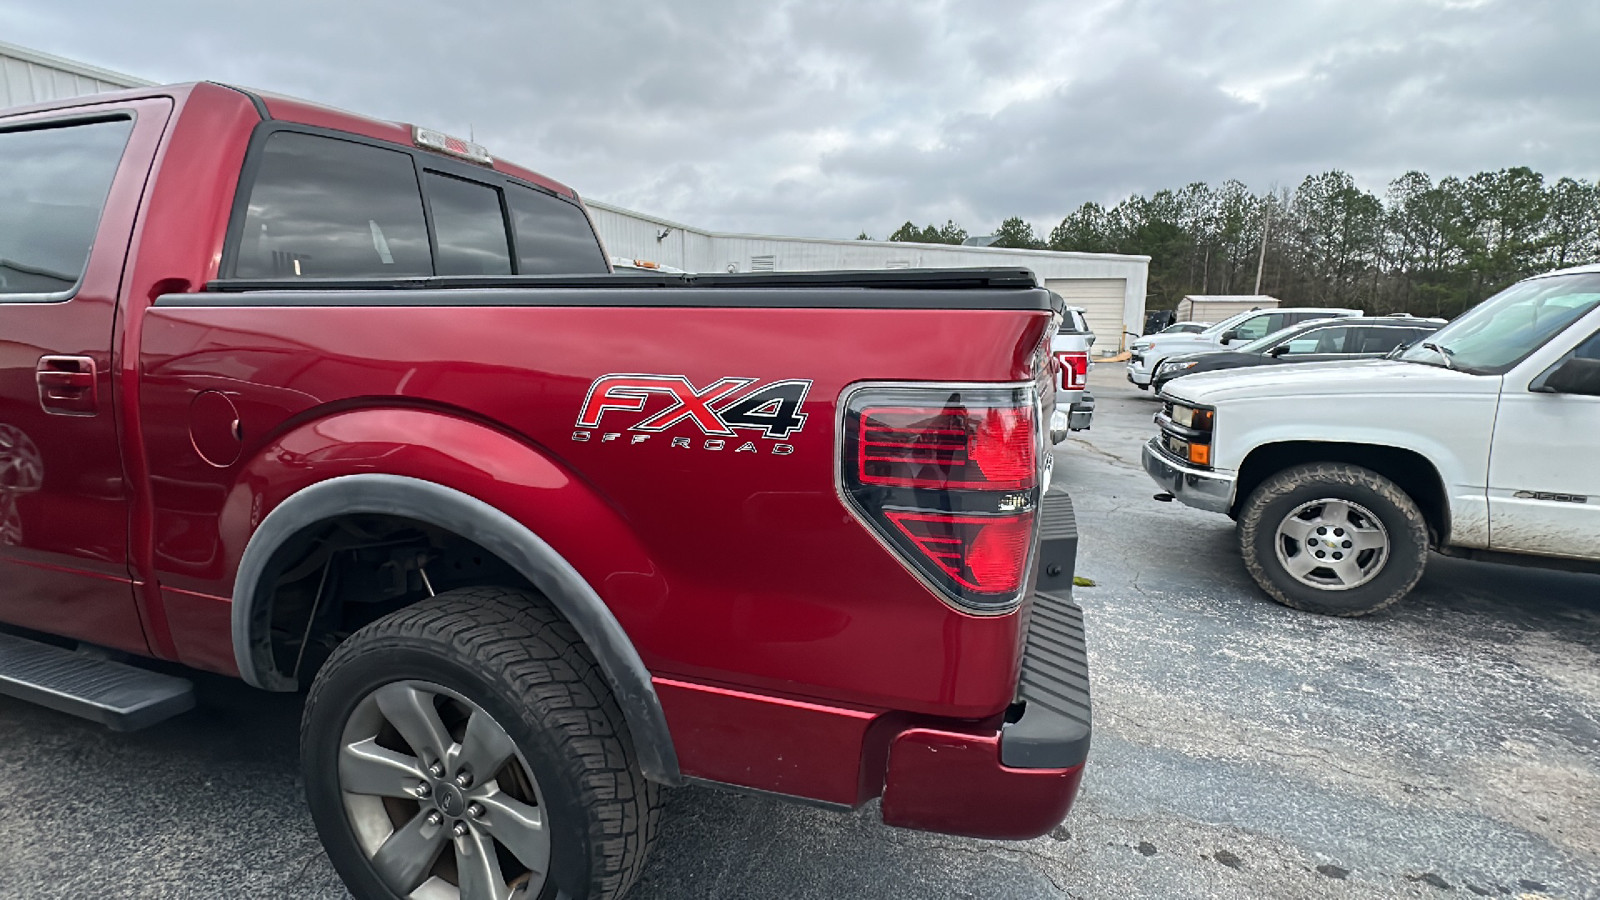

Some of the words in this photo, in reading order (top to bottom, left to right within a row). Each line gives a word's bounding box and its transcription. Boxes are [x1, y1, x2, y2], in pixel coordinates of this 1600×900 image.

[575, 372, 814, 440] FX4
[571, 430, 651, 445] OFF
[671, 436, 795, 456] ROAD
